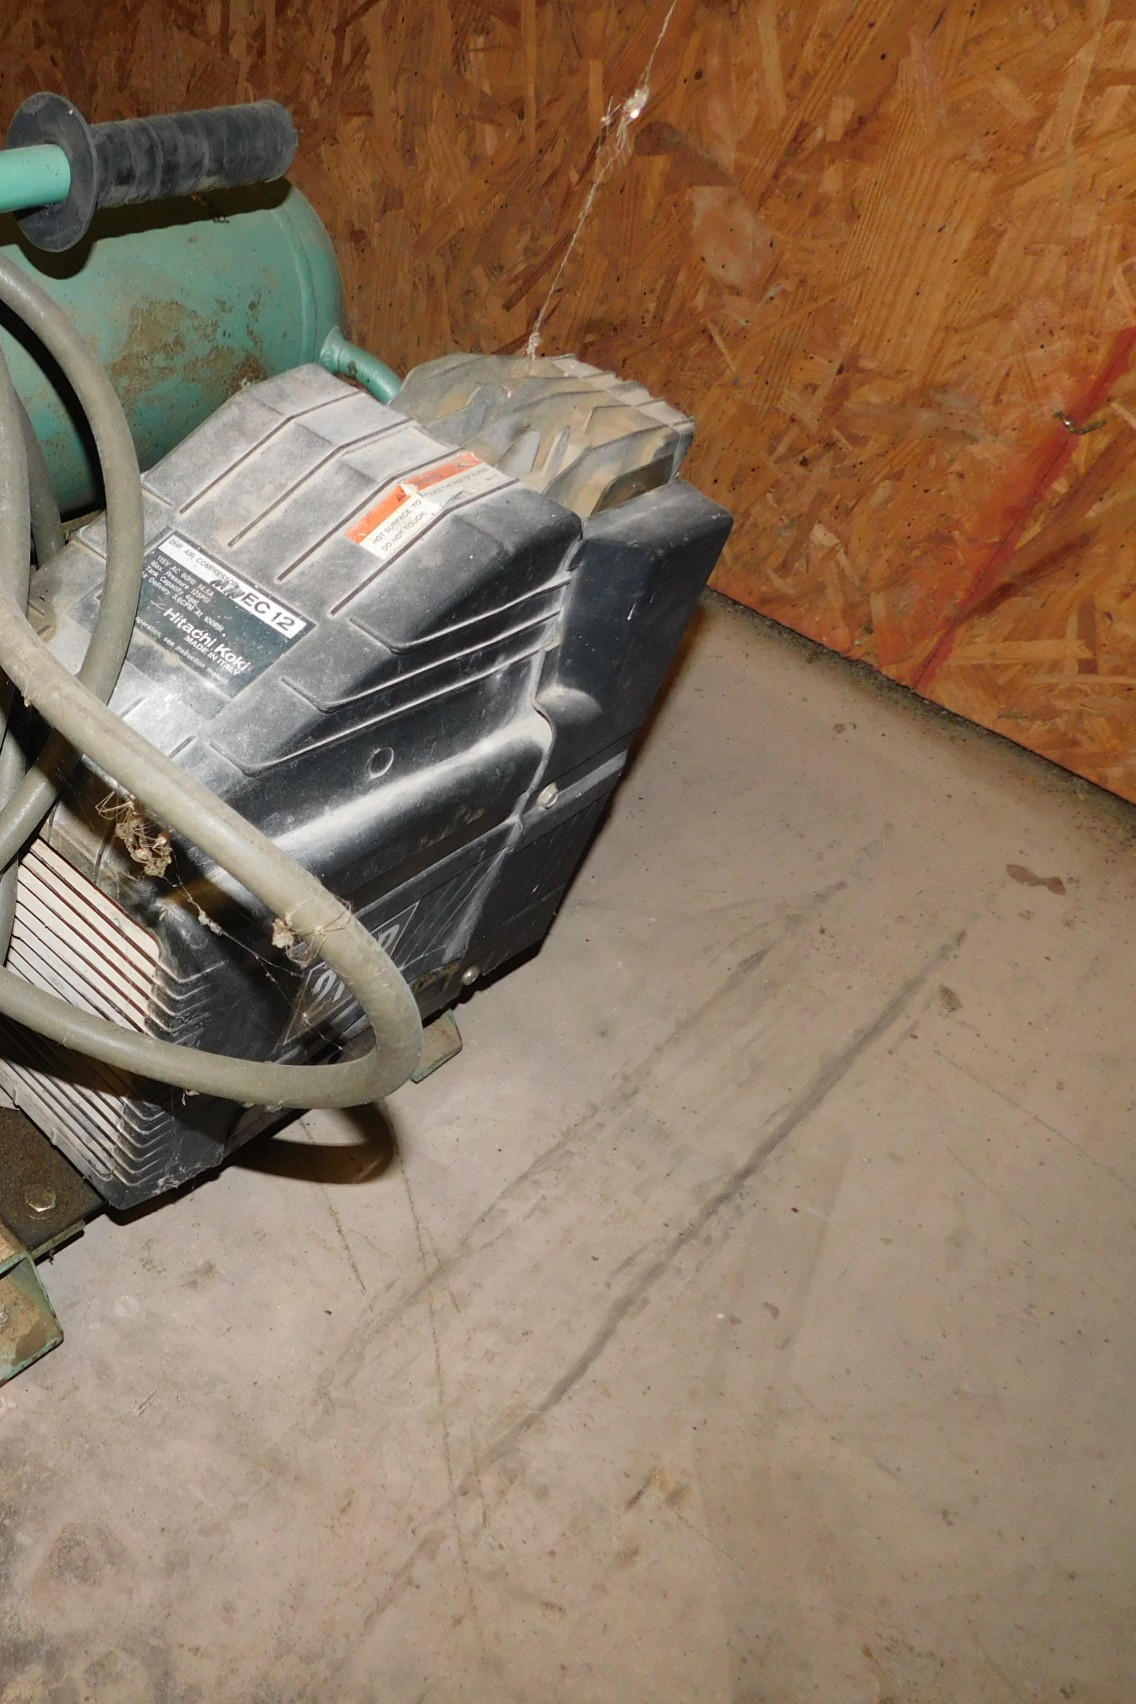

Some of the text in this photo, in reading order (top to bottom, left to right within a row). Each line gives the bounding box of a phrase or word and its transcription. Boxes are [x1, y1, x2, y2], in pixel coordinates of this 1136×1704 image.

[372, 531, 385, 544] HOT
[241, 593, 295, 630] EC 12
[162, 608, 252, 670] Hitachi Koki
[183, 635, 209, 653] MADE
[216, 659, 241, 676] ITALY
